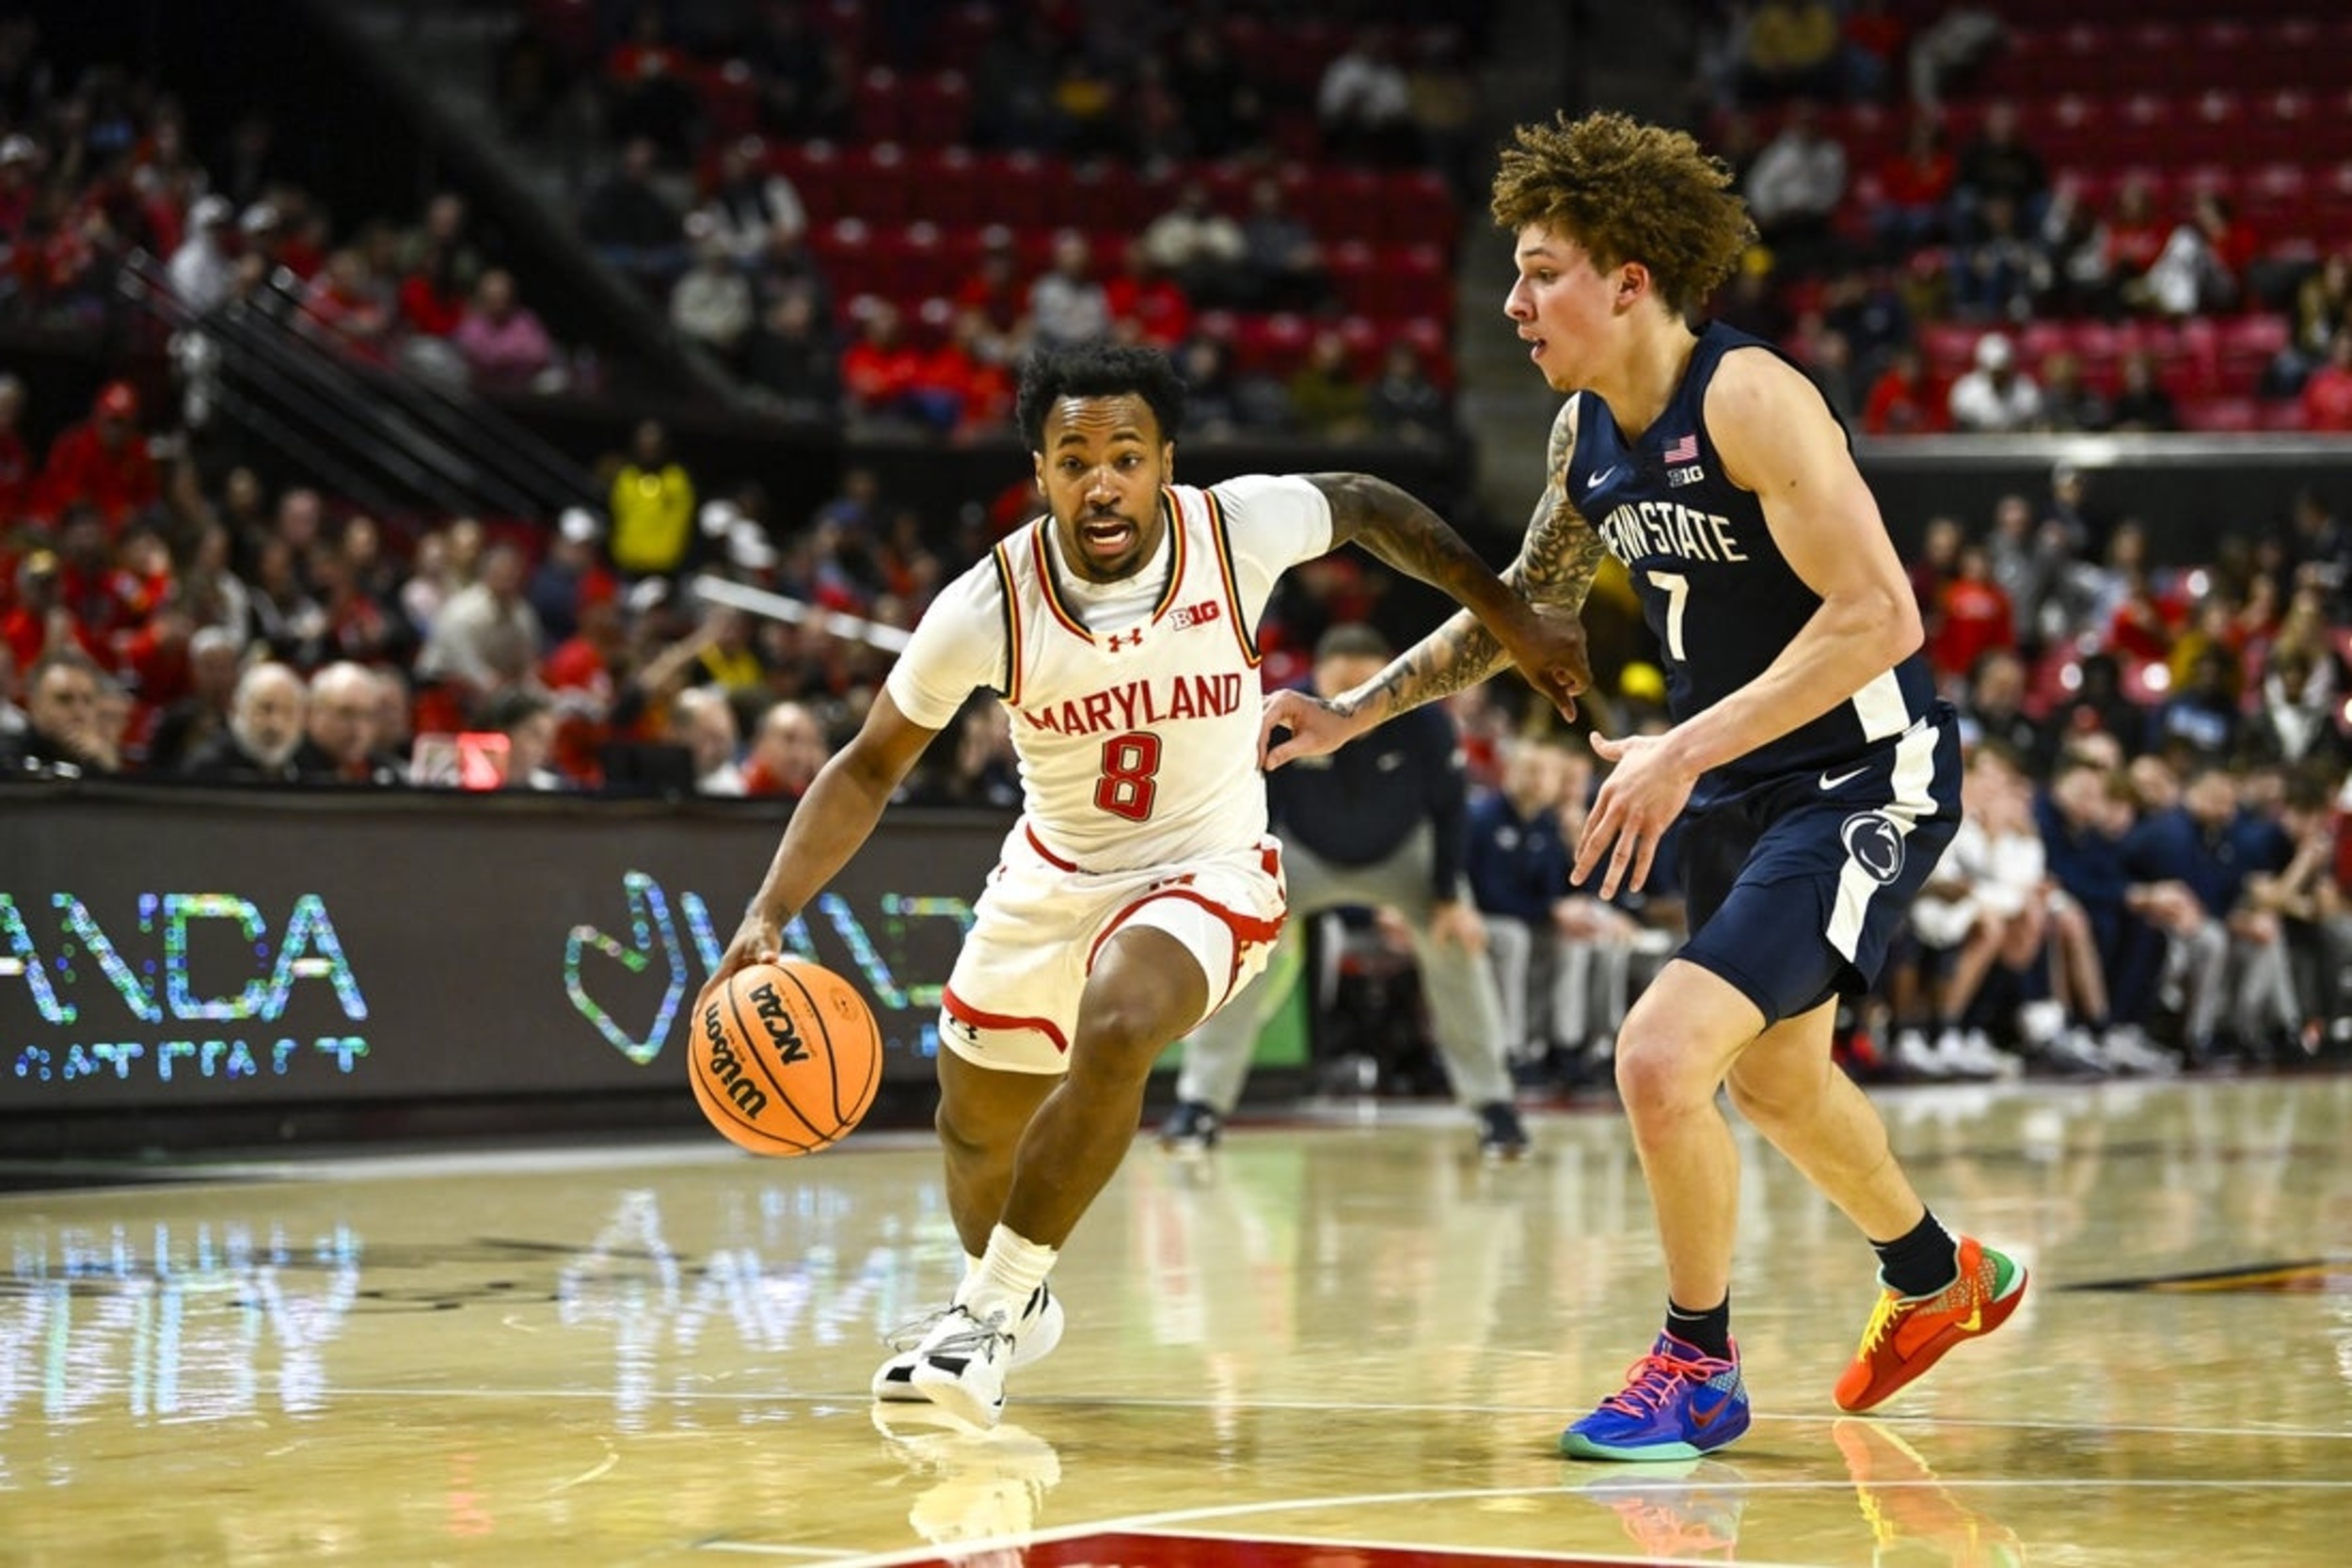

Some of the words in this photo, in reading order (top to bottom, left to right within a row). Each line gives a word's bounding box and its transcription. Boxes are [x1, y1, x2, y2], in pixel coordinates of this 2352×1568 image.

[1639, 501, 1749, 562] STATE
[1646, 570, 1690, 662] 7
[1023, 673, 1242, 736] MARYLAND
[1093, 730, 1163, 822] 8
[705, 1000, 768, 1121] Wilson
[749, 981, 810, 1066] NCAA
